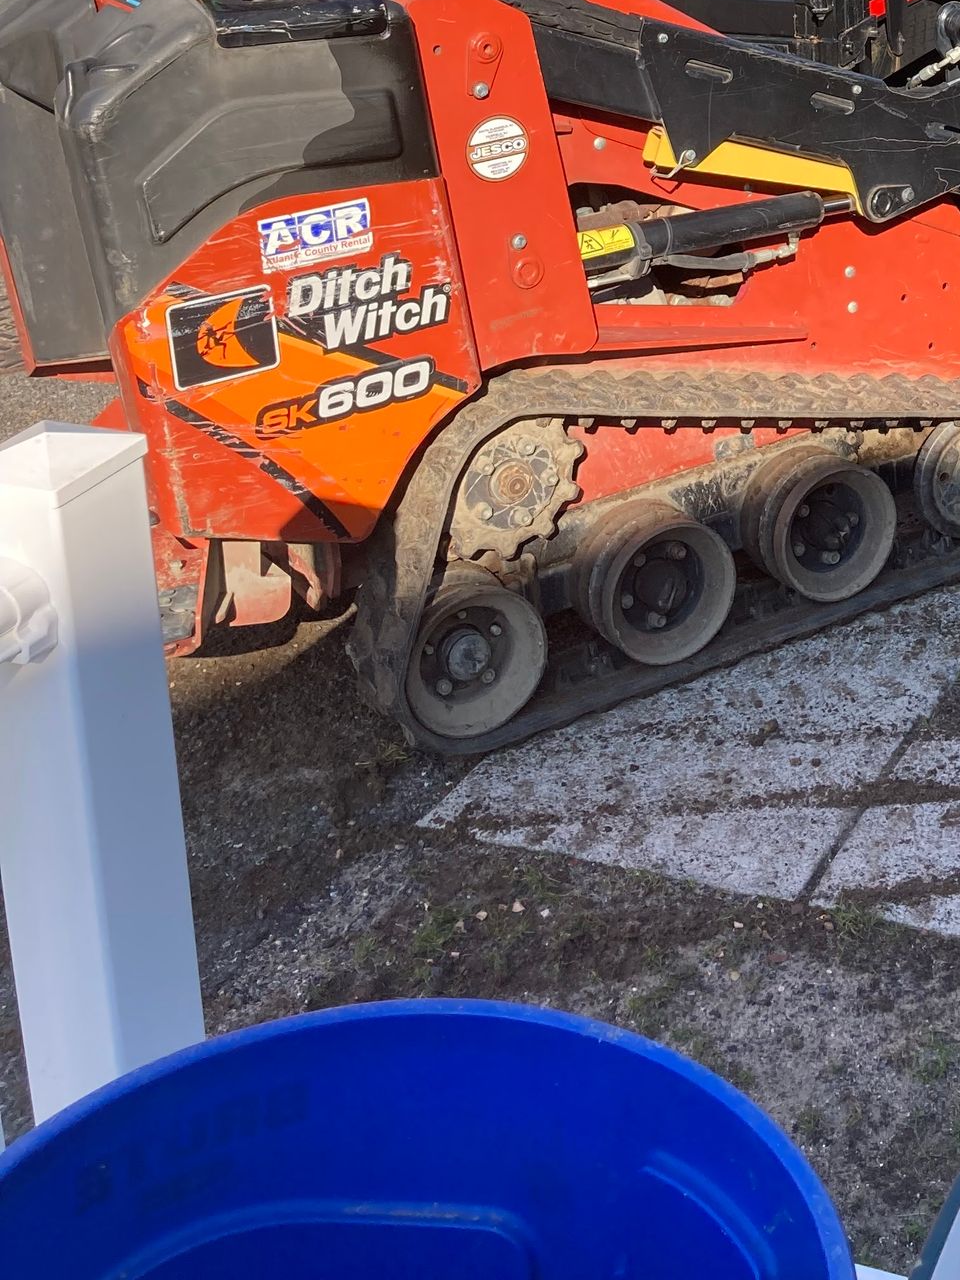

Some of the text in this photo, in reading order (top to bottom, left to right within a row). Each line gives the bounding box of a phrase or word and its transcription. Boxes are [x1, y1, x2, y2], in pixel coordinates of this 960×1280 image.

[471, 139, 526, 160] JESCO
[265, 206, 364, 255] ACR
[304, 244, 338, 258] County
[341, 236, 371, 249] Rental
[288, 256, 409, 318] Ditch
[324, 287, 448, 350] Witch
[262, 360, 431, 433] SK600
